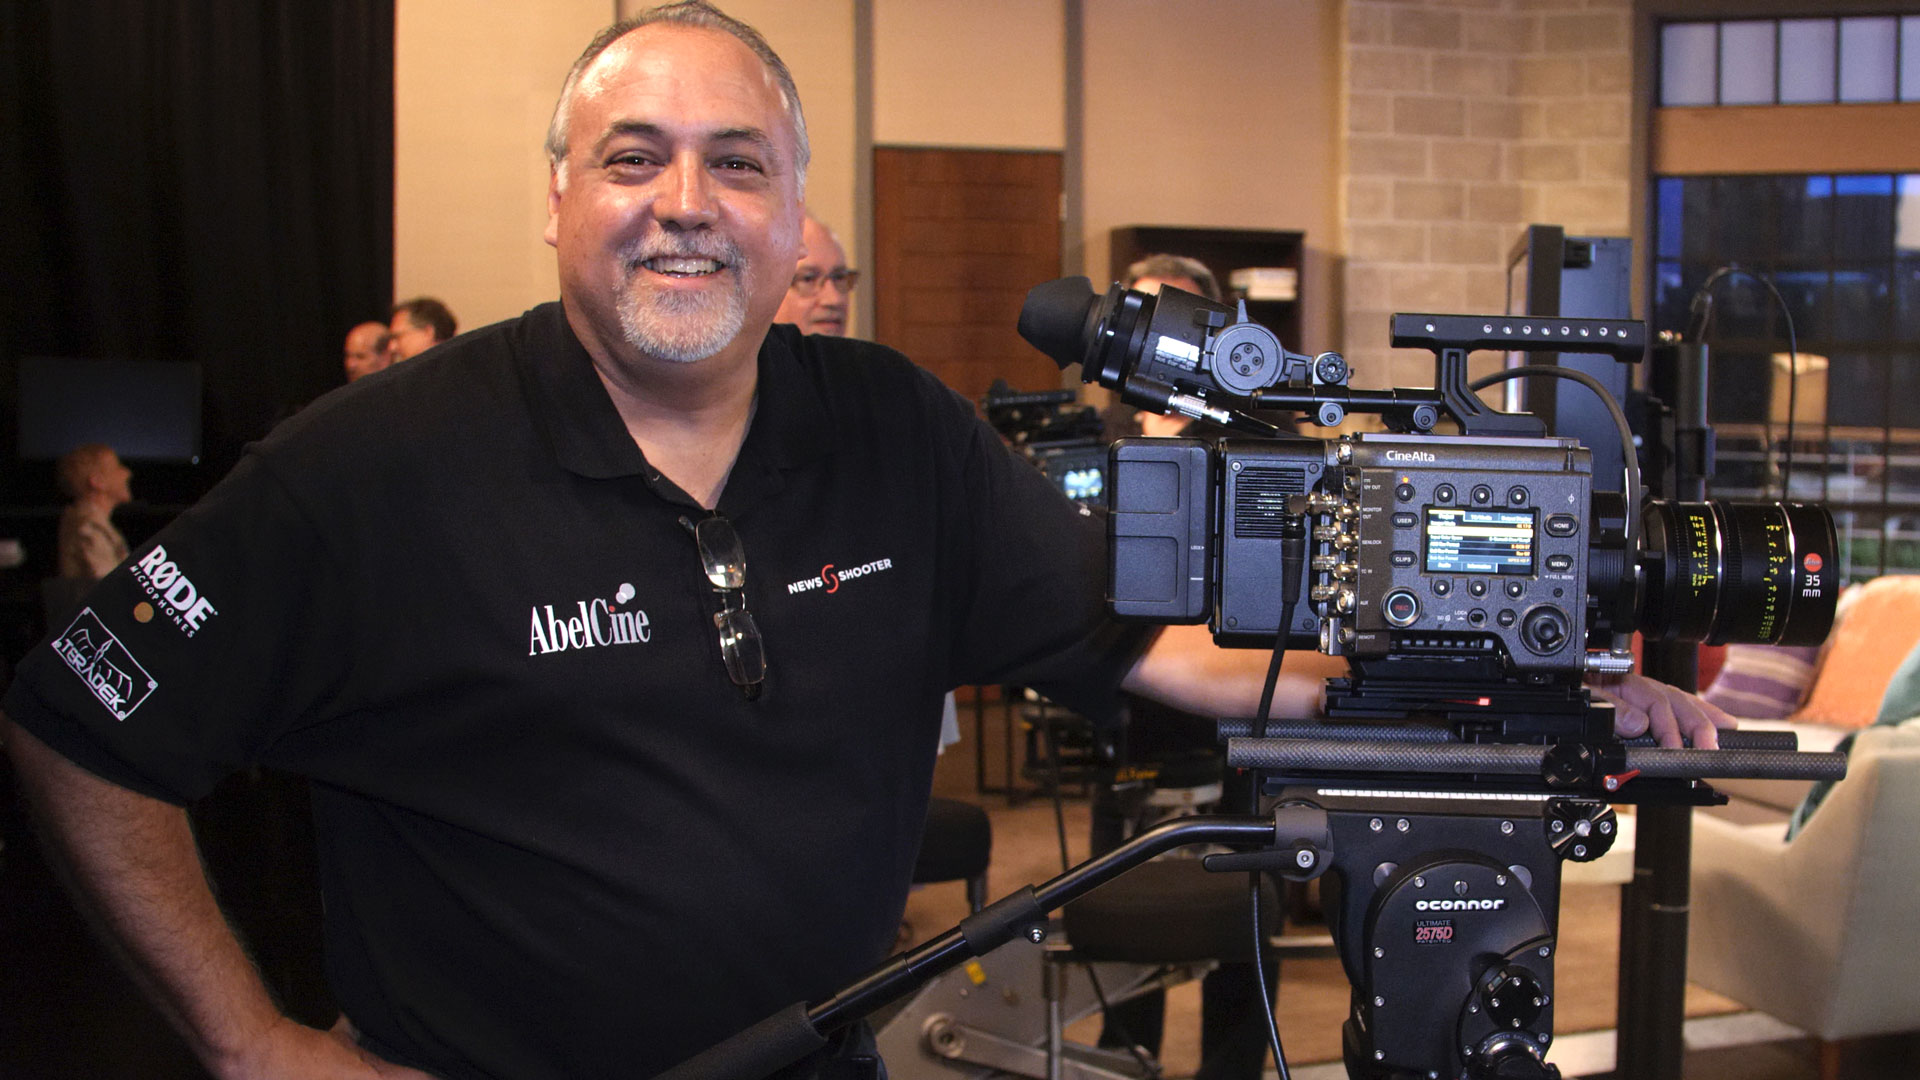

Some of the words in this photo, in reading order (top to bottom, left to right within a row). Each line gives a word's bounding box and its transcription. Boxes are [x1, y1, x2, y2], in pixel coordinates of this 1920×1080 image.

[1386, 450, 1435, 462] CineAlta
[138, 544, 214, 631] RØDE
[787, 576, 824, 594] NEWS
[837, 558, 893, 582] SHOOTER
[1805, 574, 1821, 587] 35
[129, 565, 196, 639] MICROPHONES
[1802, 589, 1821, 598] mm
[529, 597, 651, 656] AbelCine
[61, 638, 127, 711] TERADEK
[1415, 899, 1505, 911] oconnor
[1415, 926, 1453, 940] 2575D
